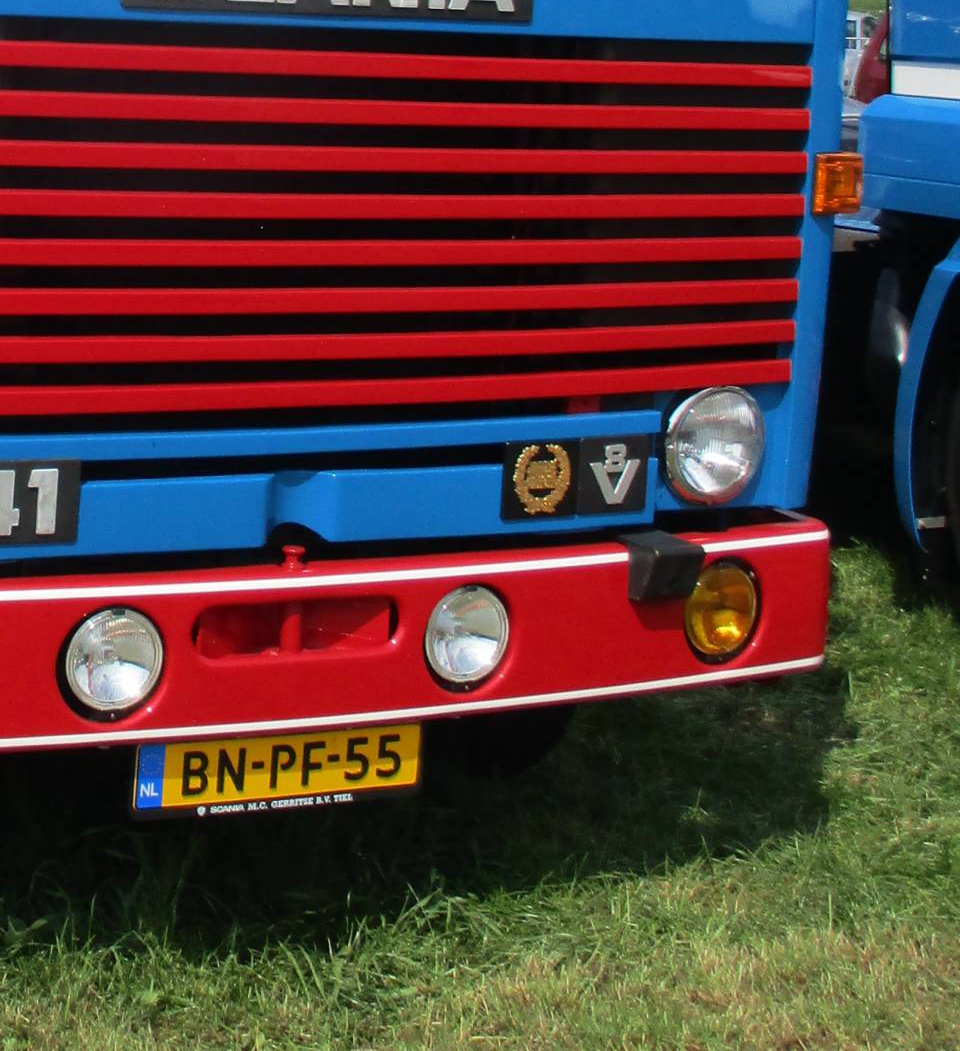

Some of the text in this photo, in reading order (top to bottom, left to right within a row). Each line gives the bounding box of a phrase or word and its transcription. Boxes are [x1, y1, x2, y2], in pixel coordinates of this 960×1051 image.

[181, 734, 401, 797] BN-PF-55
[139, 782, 159, 799] NL
[210, 804, 245, 814] SCANIA
[333, 793, 354, 803] TIEL
